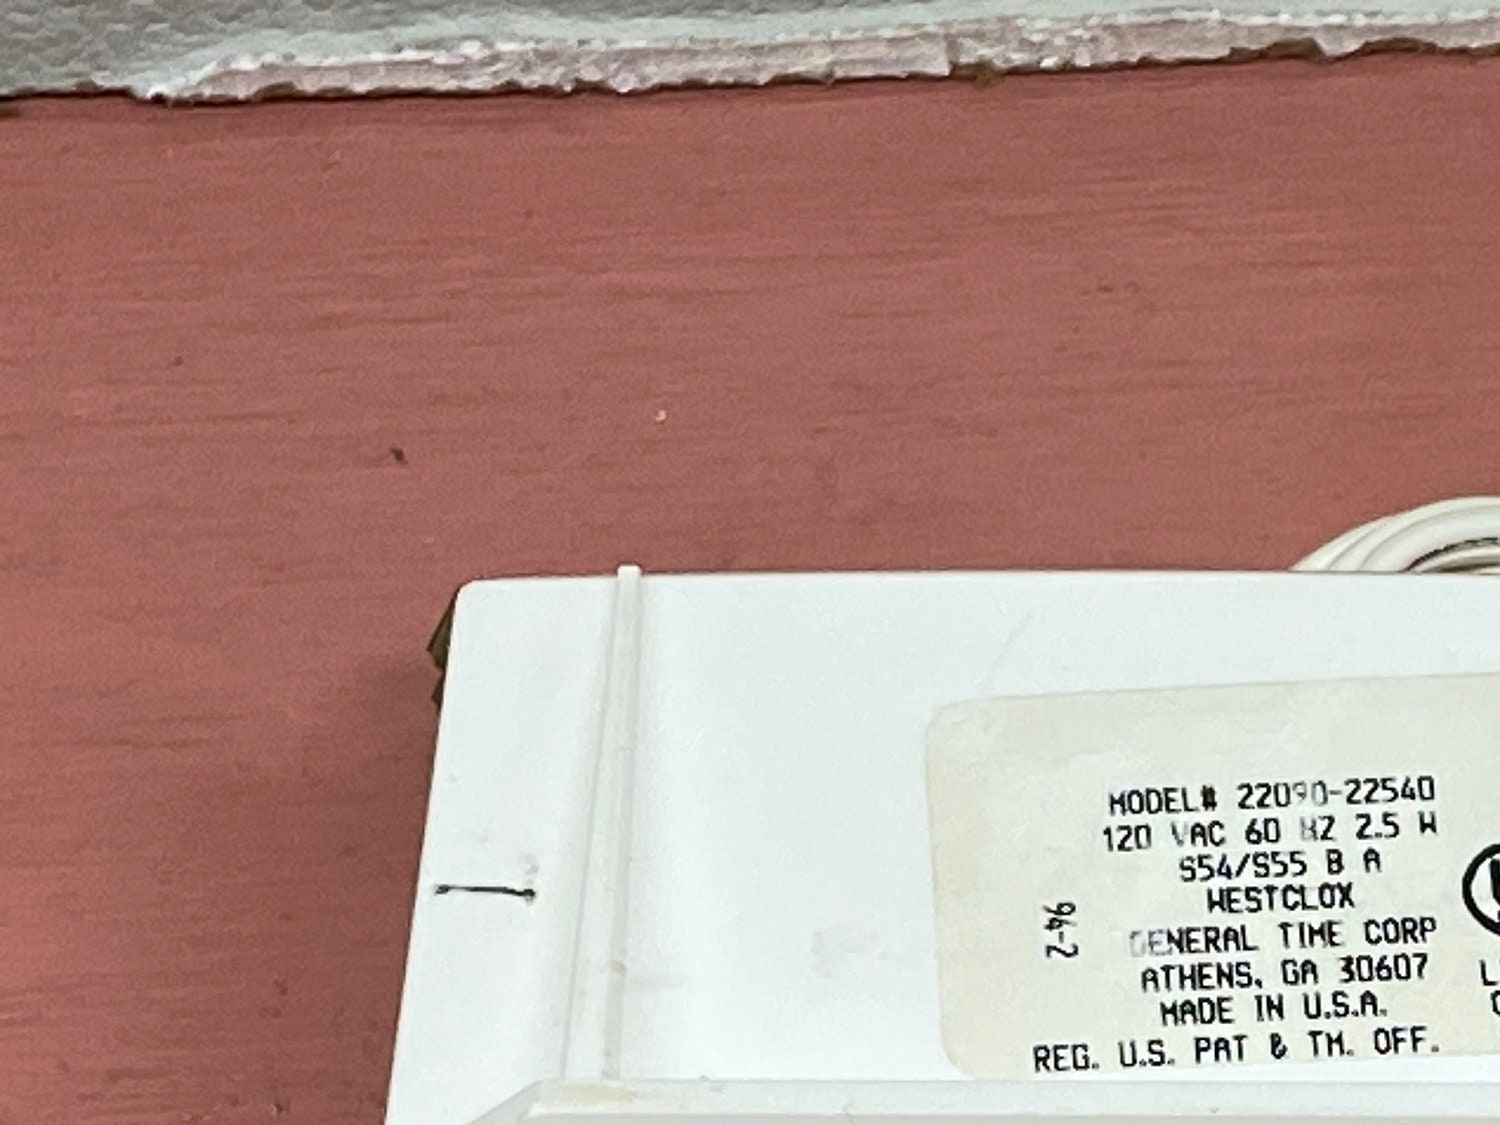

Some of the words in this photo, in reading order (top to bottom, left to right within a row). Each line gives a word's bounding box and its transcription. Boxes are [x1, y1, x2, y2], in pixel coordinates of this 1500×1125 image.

[1109, 785, 1217, 816] MODEL#
[1237, 775, 1435, 809] 22090-22540
[1104, 824, 1151, 851] 120
[1170, 820, 1225, 848] VAC
[1245, 818, 1280, 844] 60
[1355, 812, 1400, 840] 2.5
[1326, 848, 1344, 875] B
[1363, 847, 1382, 873] A
[1207, 882, 1355, 913] WESTCLOX
[1129, 924, 1259, 957] GENERAL
[1278, 920, 1344, 949] TIME
[1364, 916, 1437, 945] CORP
[1141, 961, 1263, 993] ATHENS,
[1281, 958, 1317, 986] GA
[1340, 953, 1428, 983] 30607
[1160, 996, 1234, 1026] MADE
[1256, 994, 1284, 1022] IN
[1304, 990, 1388, 1020] U.S.A.
[1032, 1043, 1099, 1073] REG.
[1119, 1038, 1175, 1068] U.S.
[1195, 1034, 1248, 1064] PAT
[1270, 1032, 1288, 1058] &
[1308, 1029, 1354, 1058] TM.
[1374, 1026, 1440, 1056] OFF.
